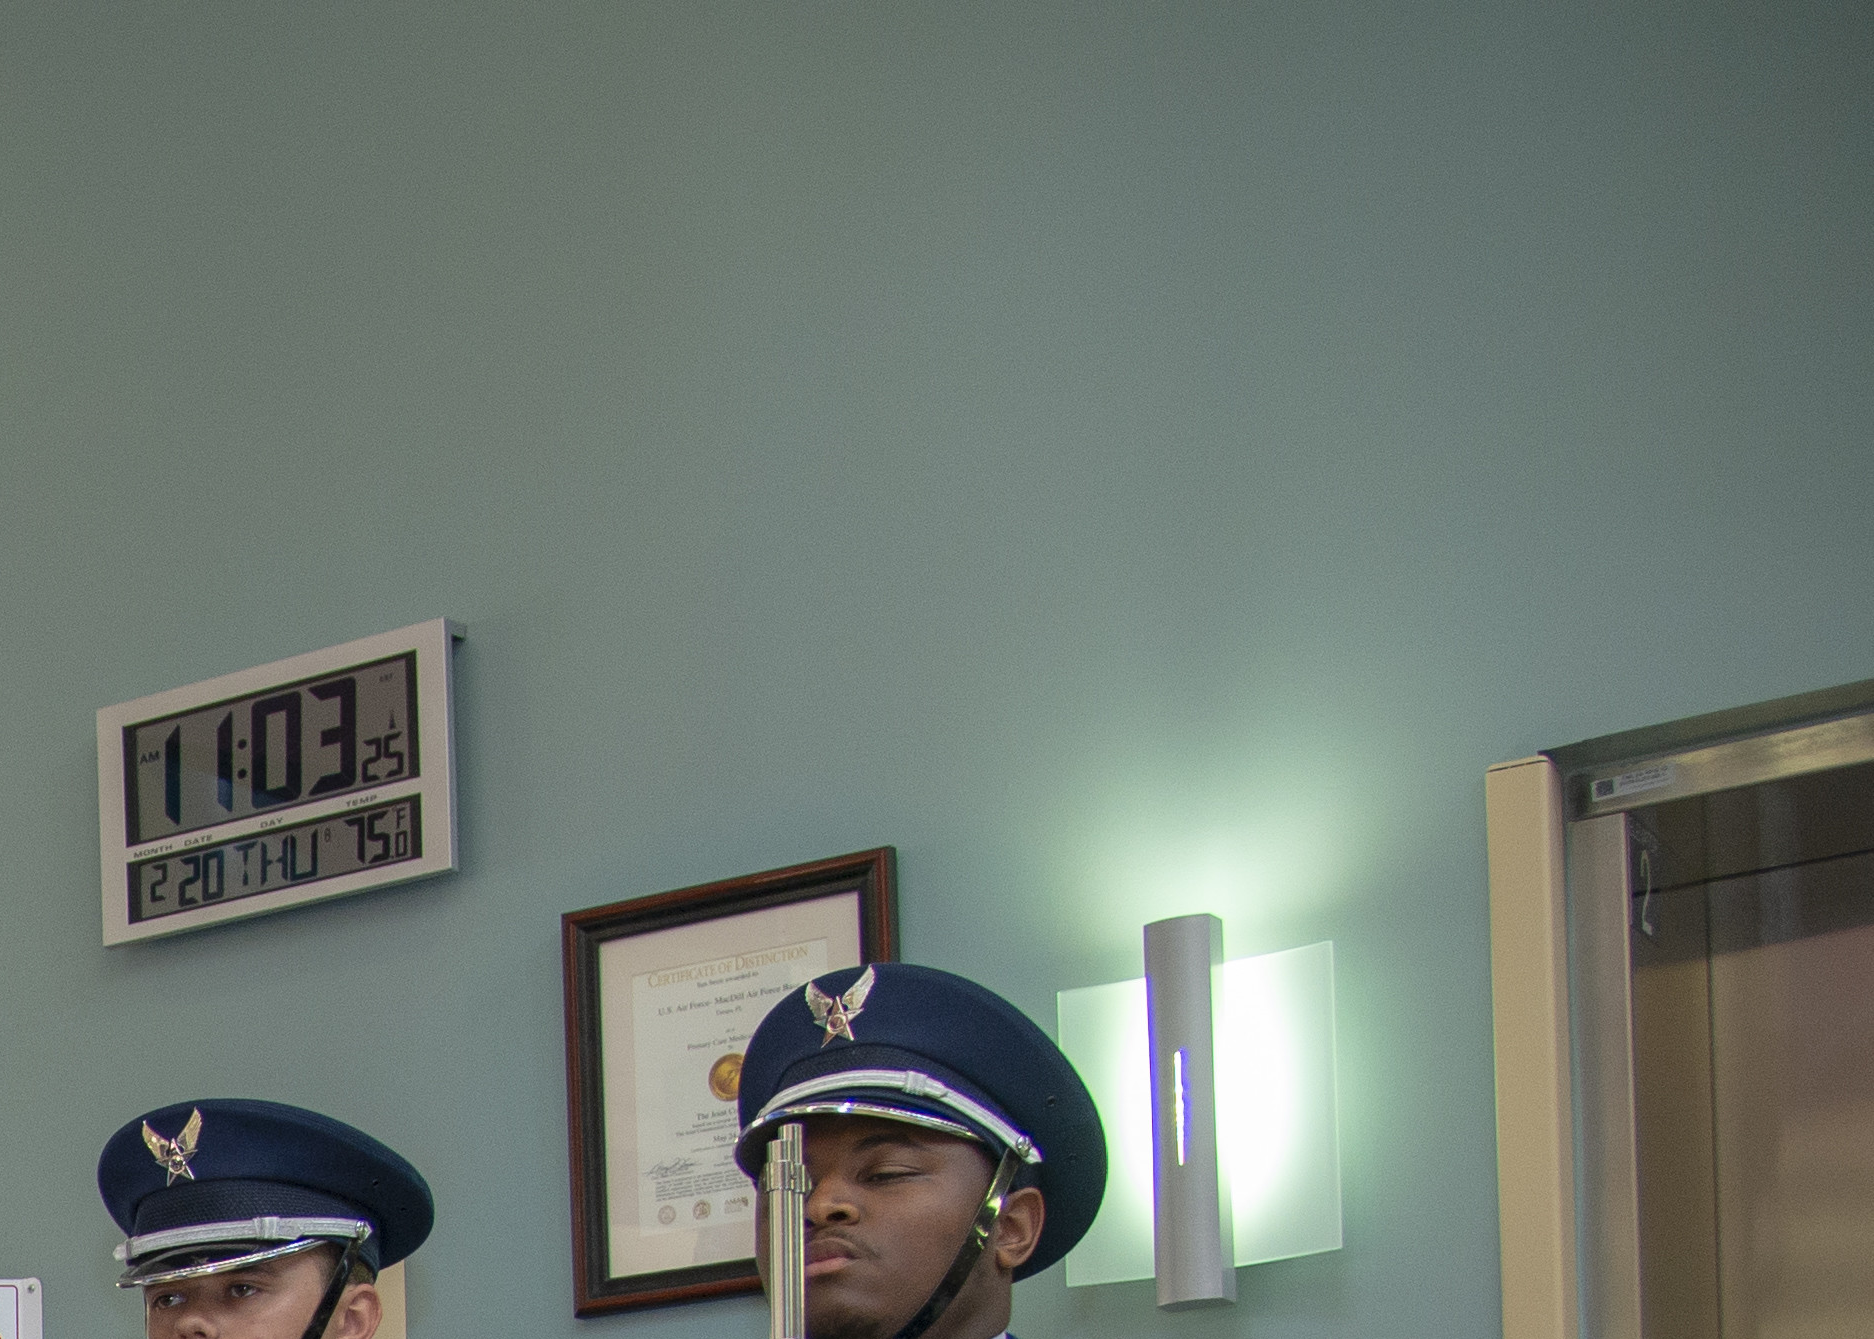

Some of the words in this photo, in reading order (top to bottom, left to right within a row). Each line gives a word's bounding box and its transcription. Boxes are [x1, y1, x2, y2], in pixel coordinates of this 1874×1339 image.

[138, 749, 161, 766] AM
[165, 676, 357, 827] 11:03
[361, 731, 404, 783] 25
[133, 844, 174, 859] MONTH
[184, 833, 214, 847] DATE
[259, 816, 284, 830] DAY
[346, 793, 379, 808] TEMP
[178, 850, 225, 908] 20
[233, 828, 319, 888] THU
[648, 966, 716, 989] CERTIFICATE
[718, 960, 731, 974] OF
[735, 945, 810, 971] DISTINCTION
